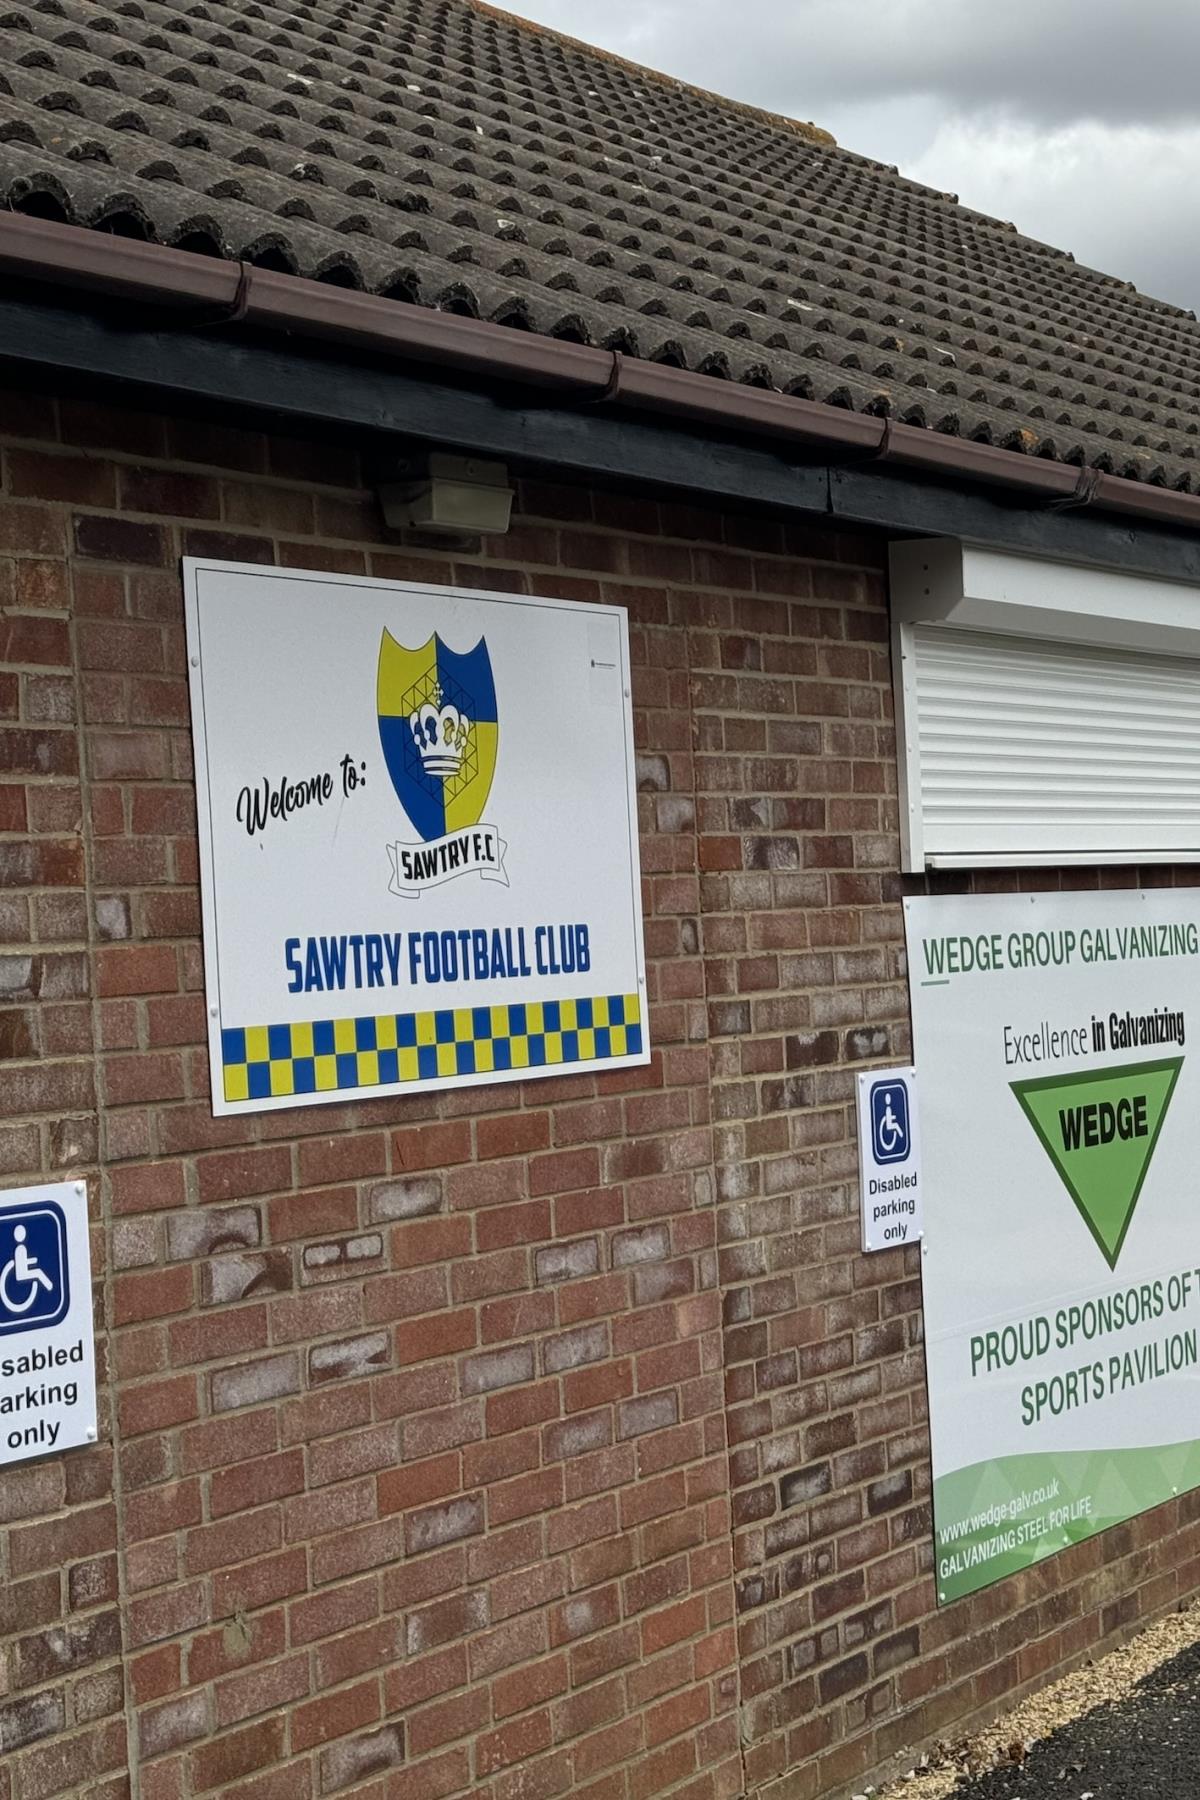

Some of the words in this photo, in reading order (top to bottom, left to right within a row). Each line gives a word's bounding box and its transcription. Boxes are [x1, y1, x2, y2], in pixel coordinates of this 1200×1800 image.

[236, 769, 333, 836] Welcome
[339, 753, 367, 798] to:
[401, 836, 471, 882] SAWTRY
[284, 931, 401, 994] SAWTRY
[408, 927, 531, 985] FOOTBALL
[534, 923, 591, 975] CLUB
[922, 934, 1004, 975] WEDGE
[1007, 929, 1076, 969] GROUP
[1080, 923, 1198, 962] GALVANIZING
[1003, 1021, 1088, 1065] Excellence
[1091, 1015, 1106, 1053] in
[1109, 1007, 1185, 1050] Galvanizing
[1058, 1095, 1148, 1152] WEDGE
[868, 1171, 918, 1196] Disabled
[873, 1199, 915, 1222] parking
[883, 1222, 908, 1241] only
[970, 1316, 1051, 1377] PROUD
[1055, 1280, 1164, 1349] SPONSORS
[1167, 1271, 1193, 1312] OF
[1021, 1361, 1104, 1426] SPORTS
[1108, 1328, 1198, 1394] PAVILION
[7, 1419, 60, 1448] only
[939, 1477, 1060, 1545] www.wedge-galv.co.uk
[940, 1529, 1016, 1579] GALVANIZING
[1018, 1516, 1048, 1546] STEEL
[1049, 1506, 1070, 1531] FOR
[1070, 1495, 1092, 1520] LIFE
